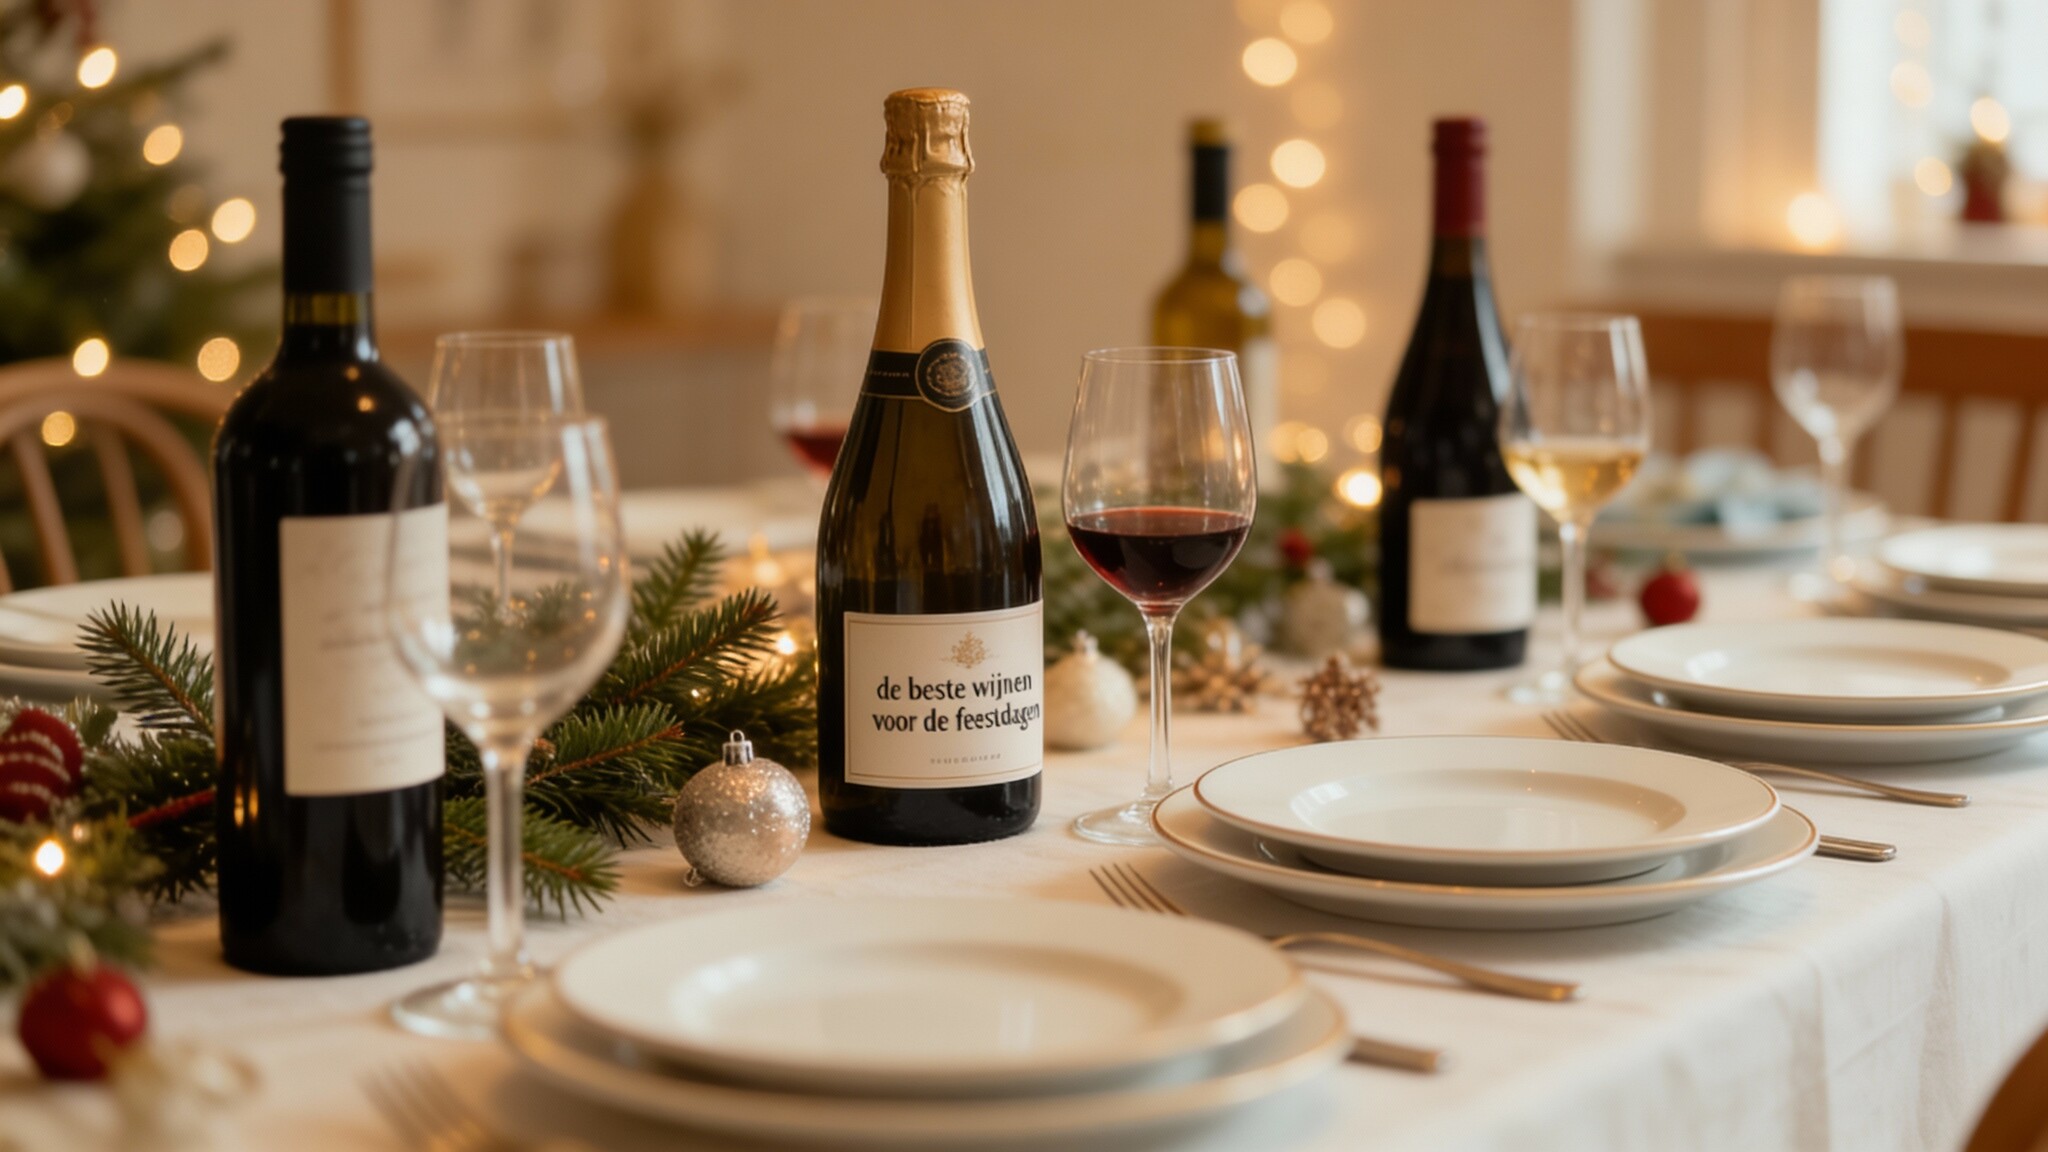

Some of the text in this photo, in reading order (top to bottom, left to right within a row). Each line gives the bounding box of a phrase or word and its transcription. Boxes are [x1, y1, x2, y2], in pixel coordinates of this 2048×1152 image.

[876, 673, 1033, 701] de beste wijnen
[872, 702, 1041, 732] voor de feestdagen
